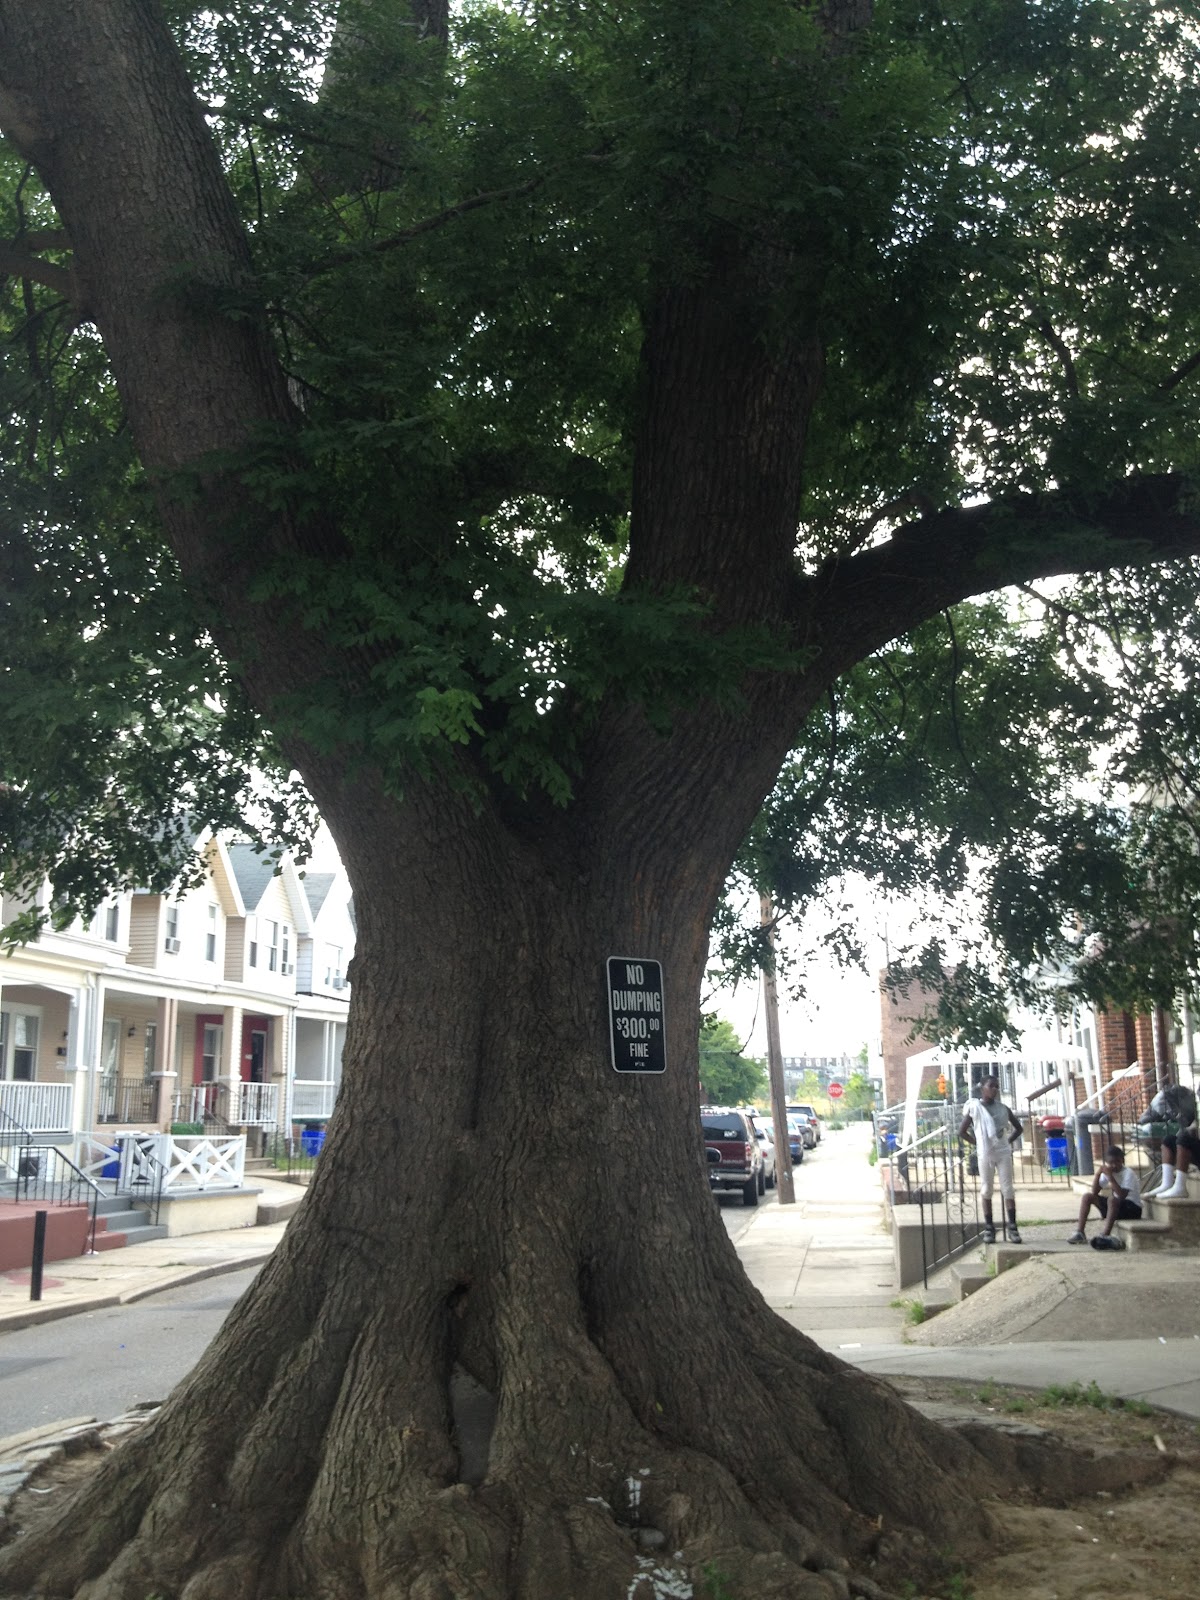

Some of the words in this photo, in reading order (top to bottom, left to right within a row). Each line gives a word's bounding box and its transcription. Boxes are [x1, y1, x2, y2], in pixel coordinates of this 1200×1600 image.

[626, 964, 645, 985] NO
[612, 990, 661, 1012] DUMPING
[629, 1043, 649, 1058] FINE
[828, 1086, 843, 1094] STOP
